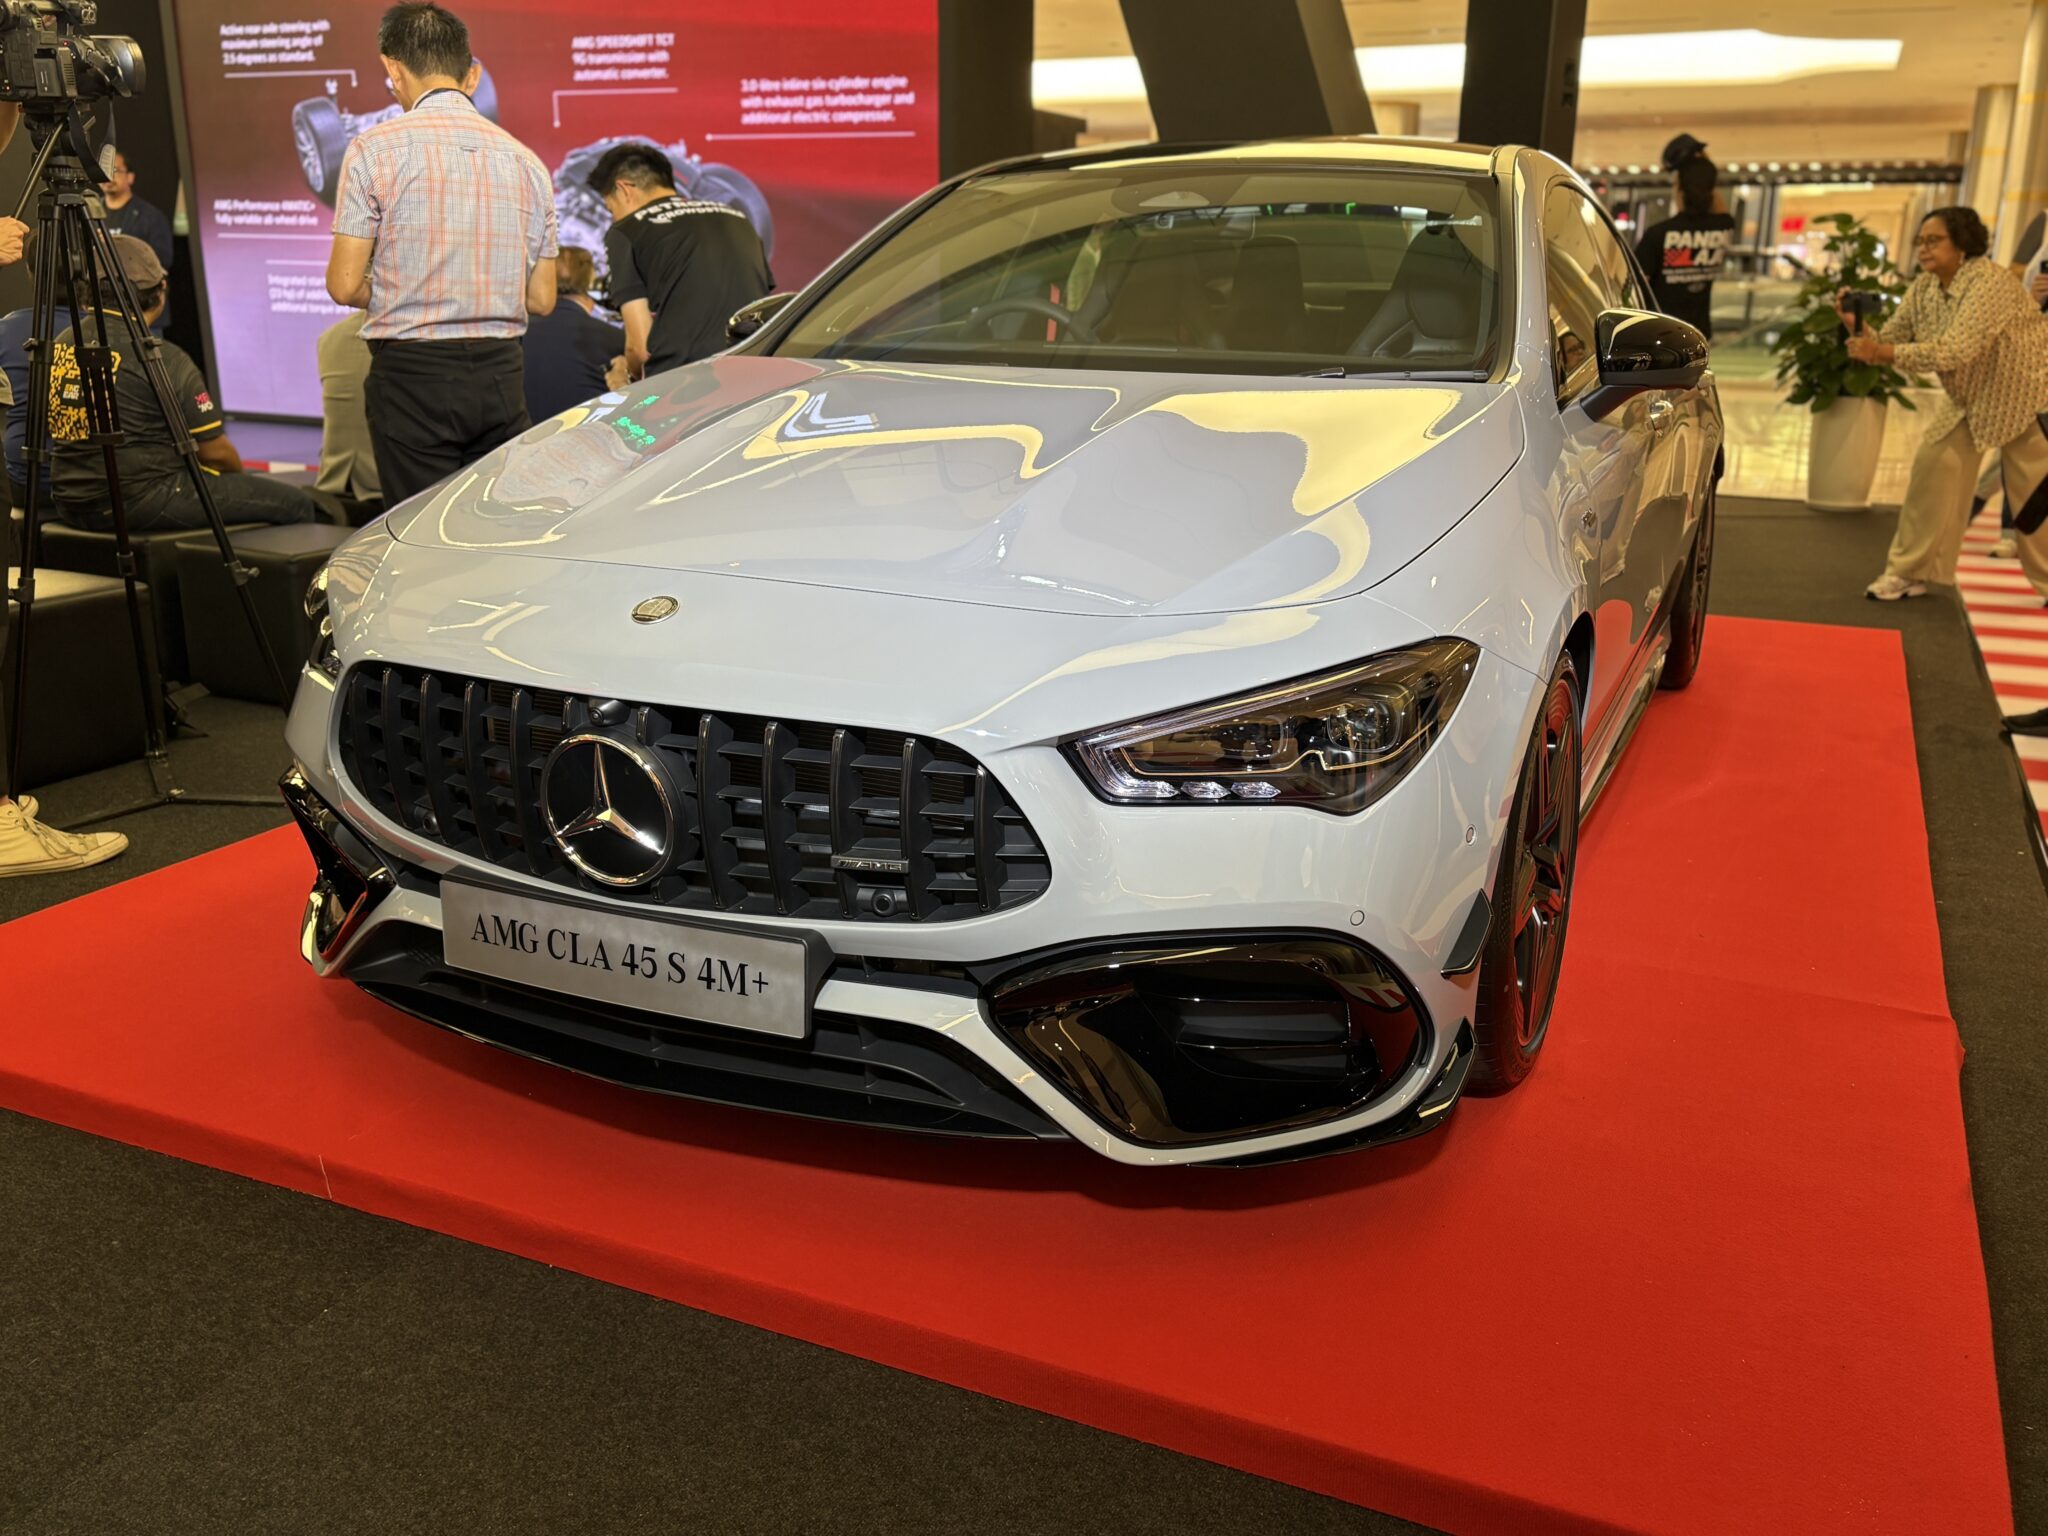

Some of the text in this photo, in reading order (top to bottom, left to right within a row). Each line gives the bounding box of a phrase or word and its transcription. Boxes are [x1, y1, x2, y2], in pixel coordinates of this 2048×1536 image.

[472, 913, 769, 996] AMG CLA 45 S 4M+
